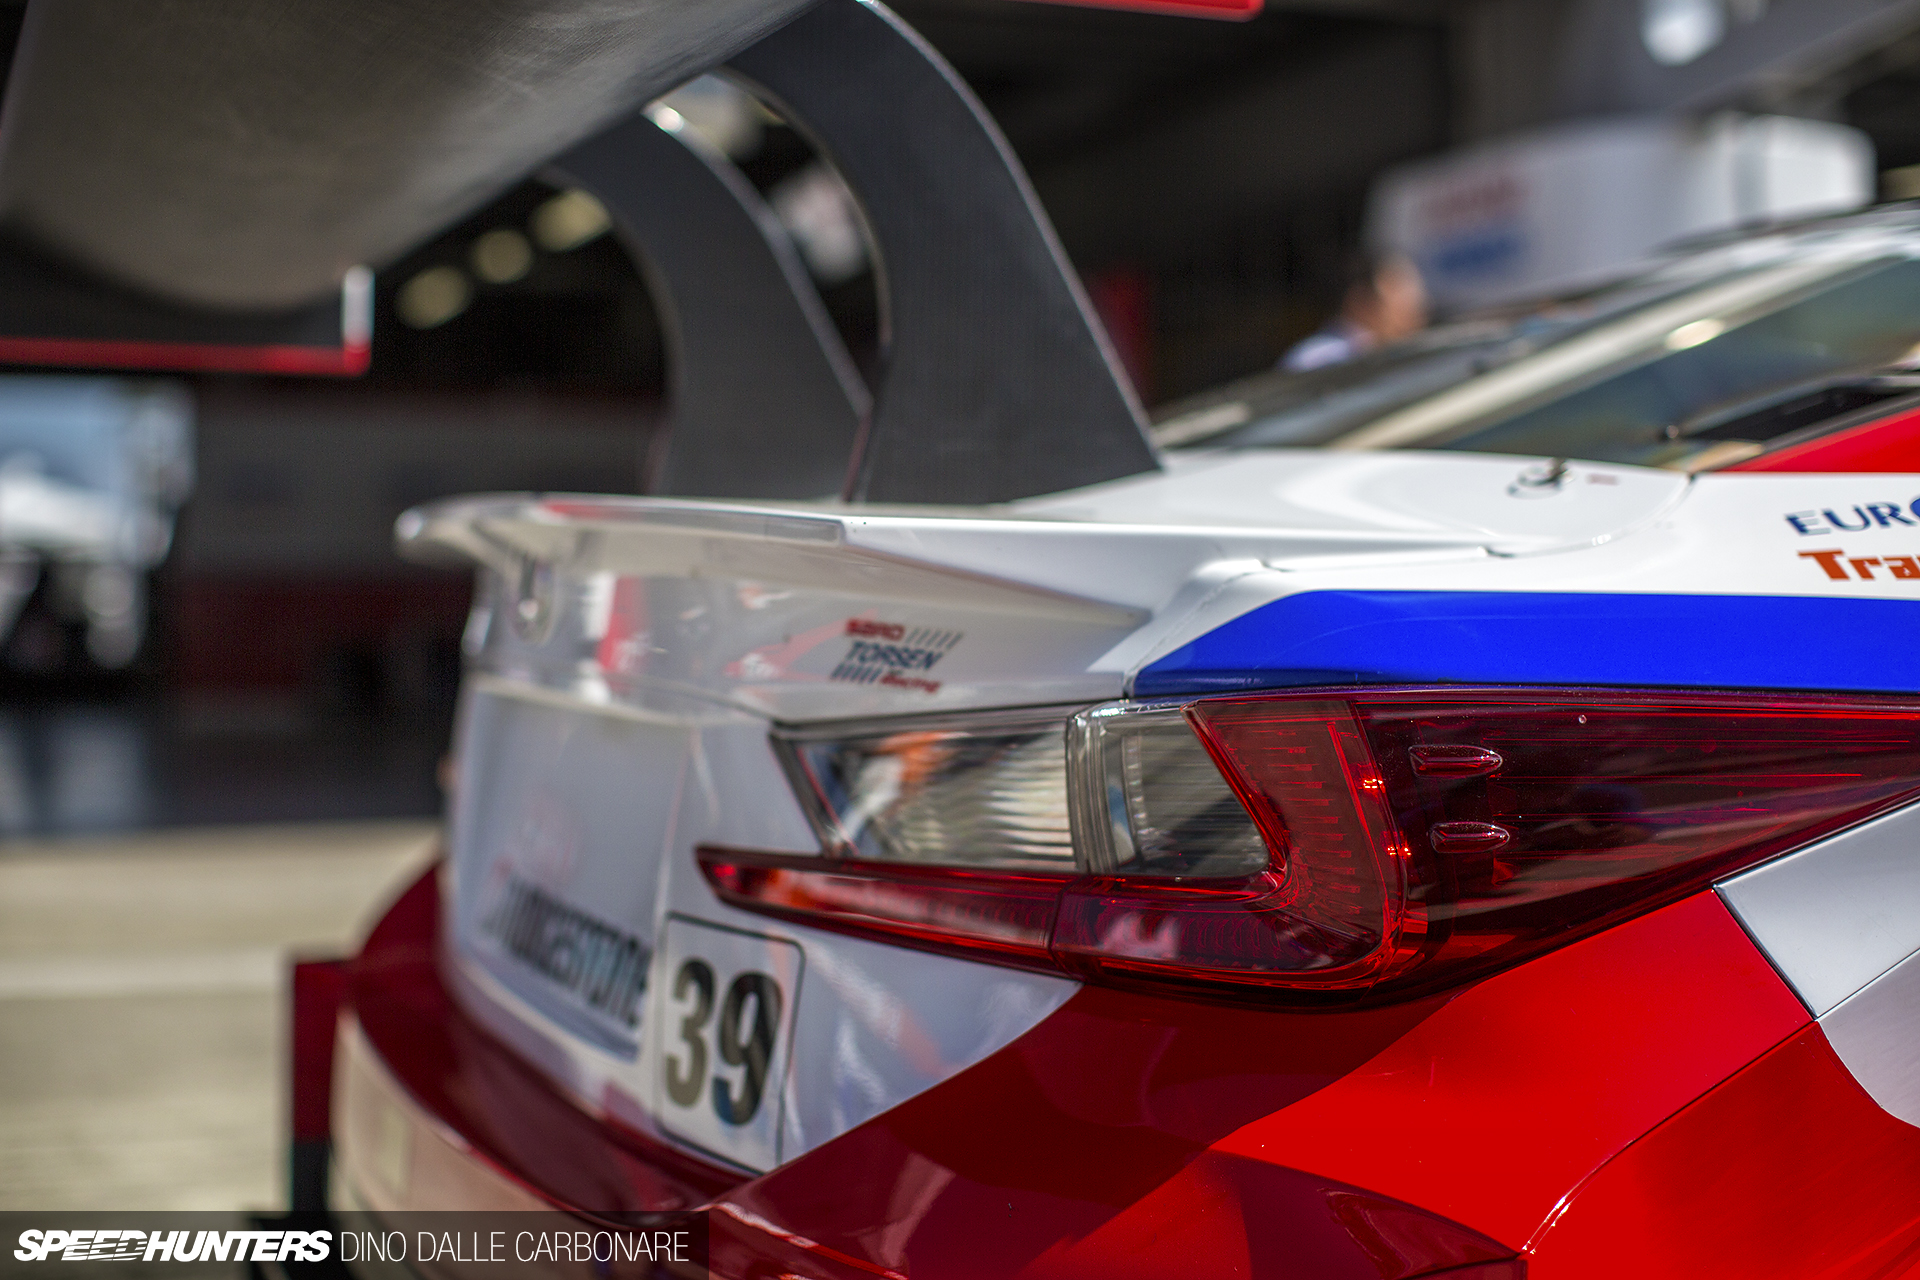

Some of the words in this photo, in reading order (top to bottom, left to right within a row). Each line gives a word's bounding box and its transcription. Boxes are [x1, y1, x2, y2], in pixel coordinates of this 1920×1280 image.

[1796, 548, 1920, 581] Tra
[846, 640, 944, 671] TORSEN
[664, 954, 784, 1126] 39
